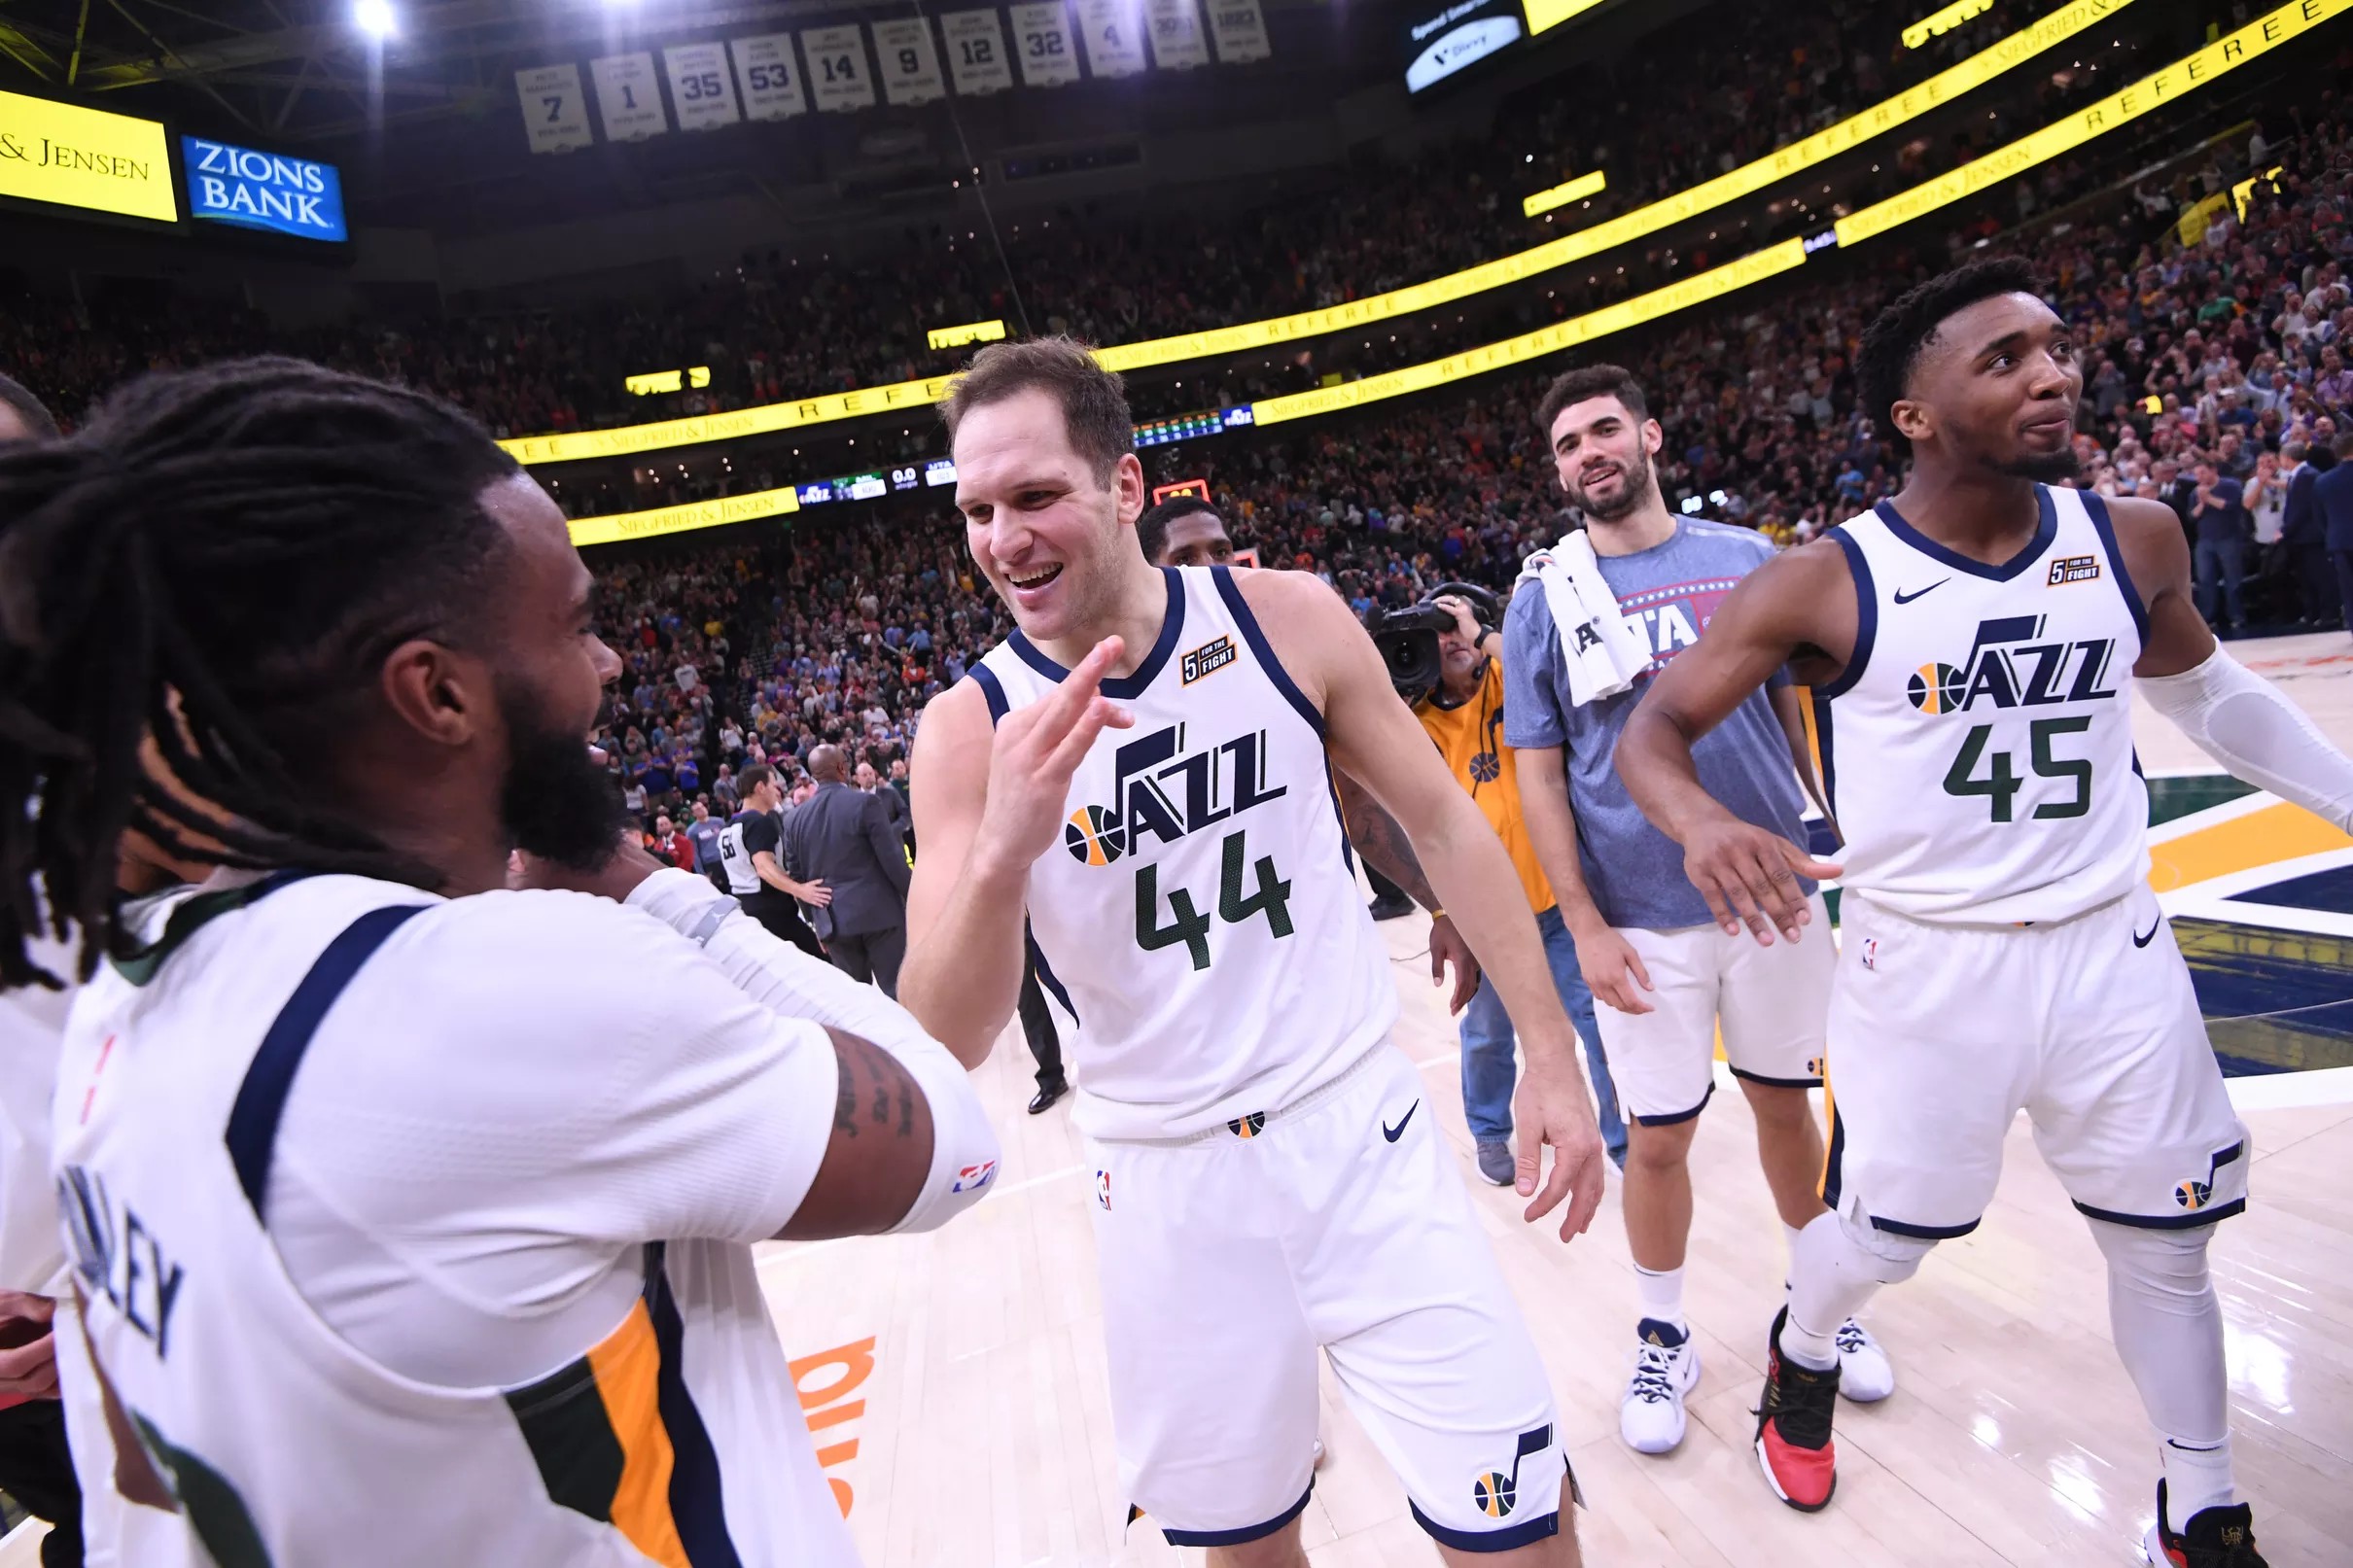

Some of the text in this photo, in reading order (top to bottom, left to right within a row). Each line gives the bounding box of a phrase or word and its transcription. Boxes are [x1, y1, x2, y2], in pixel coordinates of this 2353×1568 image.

[961, 38, 993, 65] 12
[1027, 31, 1064, 56] 32
[821, 54, 857, 83] 14
[898, 49, 919, 74] 9
[2086, 0, 2323, 130] REFEREE
[681, 72, 722, 100] 35
[749, 63, 790, 91] 53
[542, 96, 562, 122] 7
[621, 84, 637, 110] 1
[0, 133, 148, 181] & JENSEN
[194, 139, 325, 193] ZIONS
[892, 468, 917, 483] 0.0
[618, 497, 775, 535] SIEGFRIED & JENSEN
[2051, 562, 2098, 584] 5 FIGHT
[1201, 639, 1226, 657] FOR THE
[1184, 648, 1233, 681] 5 FIGHT
[1908, 613, 2118, 714] JAZZ
[1943, 714, 2092, 822] 45
[1066, 721, 1288, 866] JAZZ
[1136, 829, 1295, 971] 44
